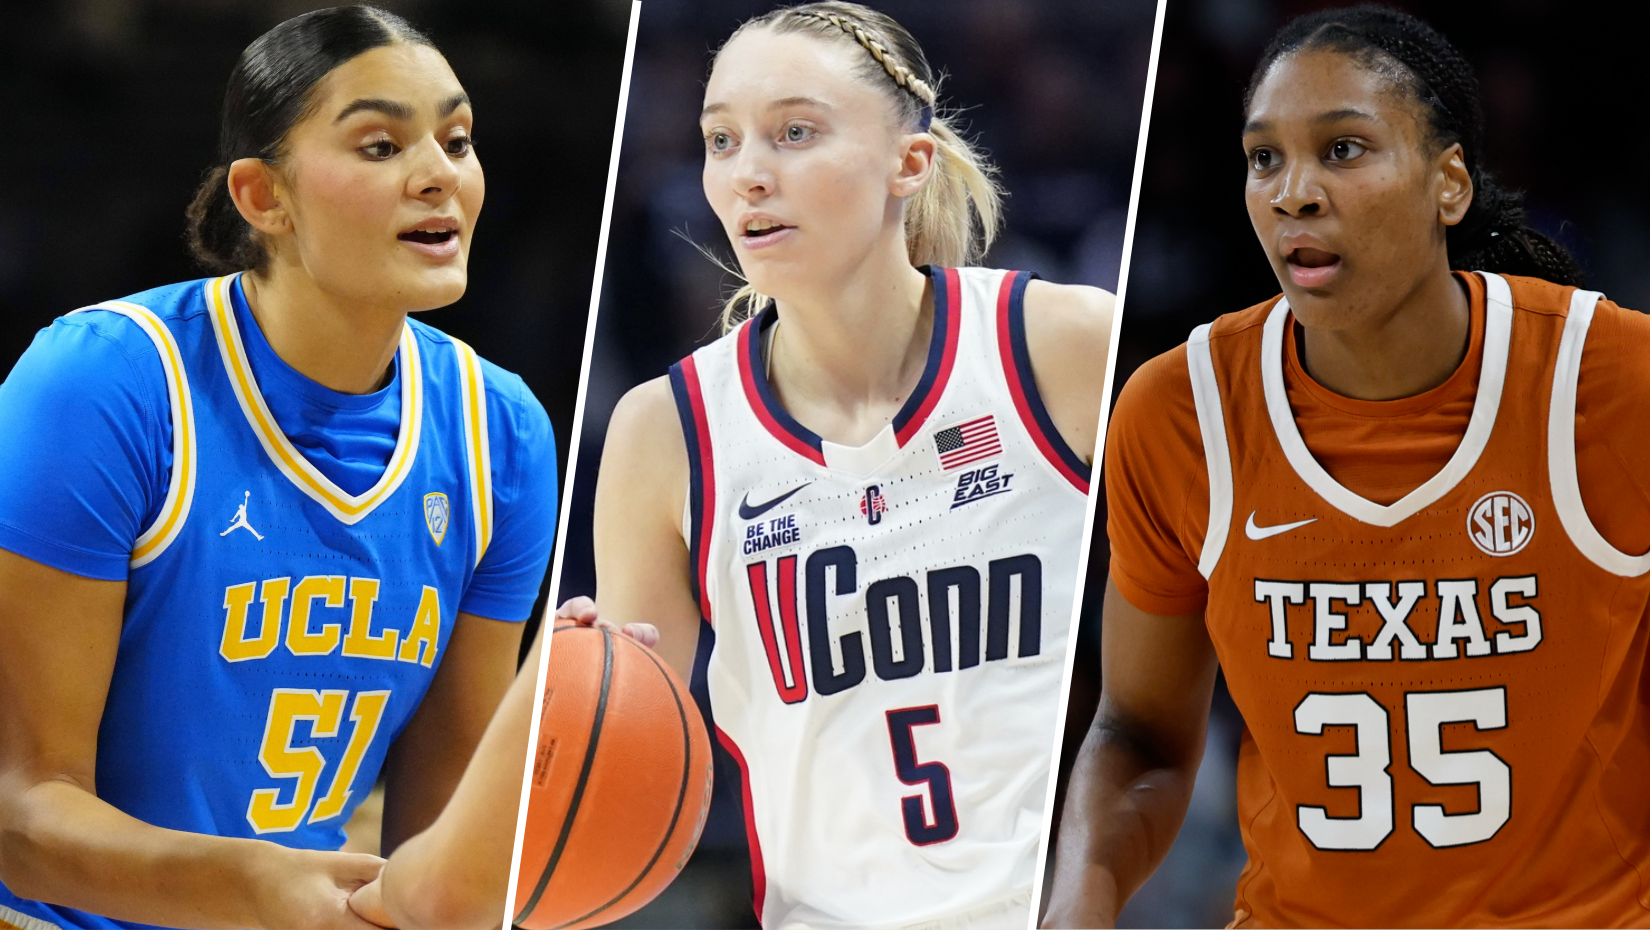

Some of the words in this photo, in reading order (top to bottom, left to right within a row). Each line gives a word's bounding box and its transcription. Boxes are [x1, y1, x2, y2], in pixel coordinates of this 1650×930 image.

[953, 473, 1014, 502] EAST
[957, 463, 999, 488] BIG
[426, 495, 448, 523] PAC
[432, 515, 443, 534] 12
[746, 522, 764, 539] BE
[769, 514, 796, 532] THE
[1473, 496, 1529, 552] SEC
[743, 527, 800, 555] CHANGE
[219, 574, 441, 668] UCLA
[1253, 573, 1544, 662] TEXAS
[246, 688, 392, 835] 51
[884, 703, 960, 847] 5
[1293, 684, 1512, 852] 35
